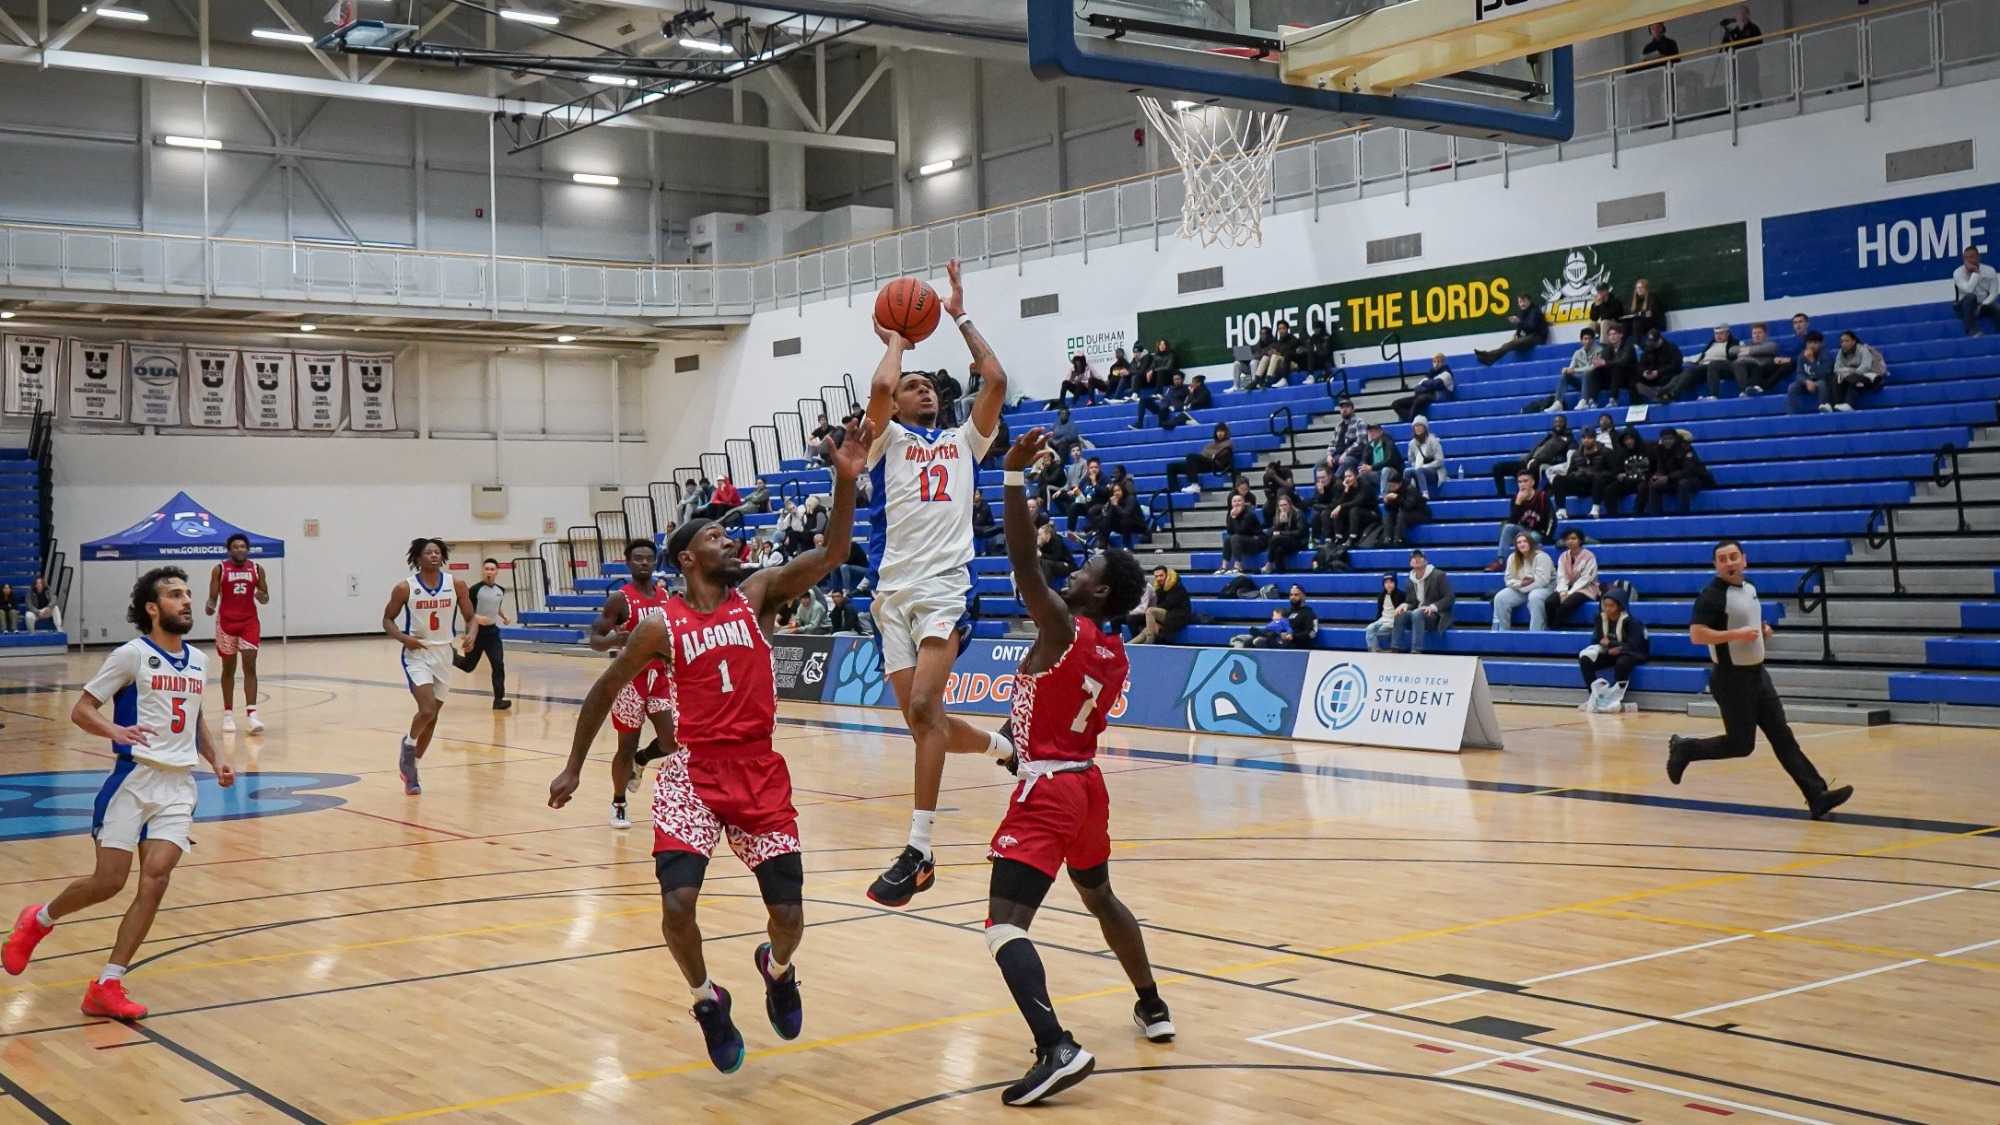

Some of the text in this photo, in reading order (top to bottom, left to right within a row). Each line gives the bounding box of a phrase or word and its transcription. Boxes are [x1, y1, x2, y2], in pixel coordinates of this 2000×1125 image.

[1858, 209, 1988, 269] HOME
[1225, 306, 1300, 348] HOME
[1347, 292, 1403, 333] THE
[1411, 277, 1510, 325] LORDS
[1086, 330, 1125, 345] DURHAM
[1086, 341, 1125, 355] COLLEGE
[134, 366, 179, 377] OUA
[920, 466, 952, 501] 12
[234, 583, 246, 594] 25
[430, 611, 440, 631] 6
[681, 619, 754, 666] ALGOMA
[151, 675, 203, 695] ONTARIO TECH
[718, 660, 734, 693] 1
[1378, 675, 1449, 686] ONTARIO TECH
[1070, 674, 1104, 733] 7
[1374, 688, 1455, 706] STUDENT
[171, 697, 187, 734] 5
[1370, 708, 1427, 725] UNION
